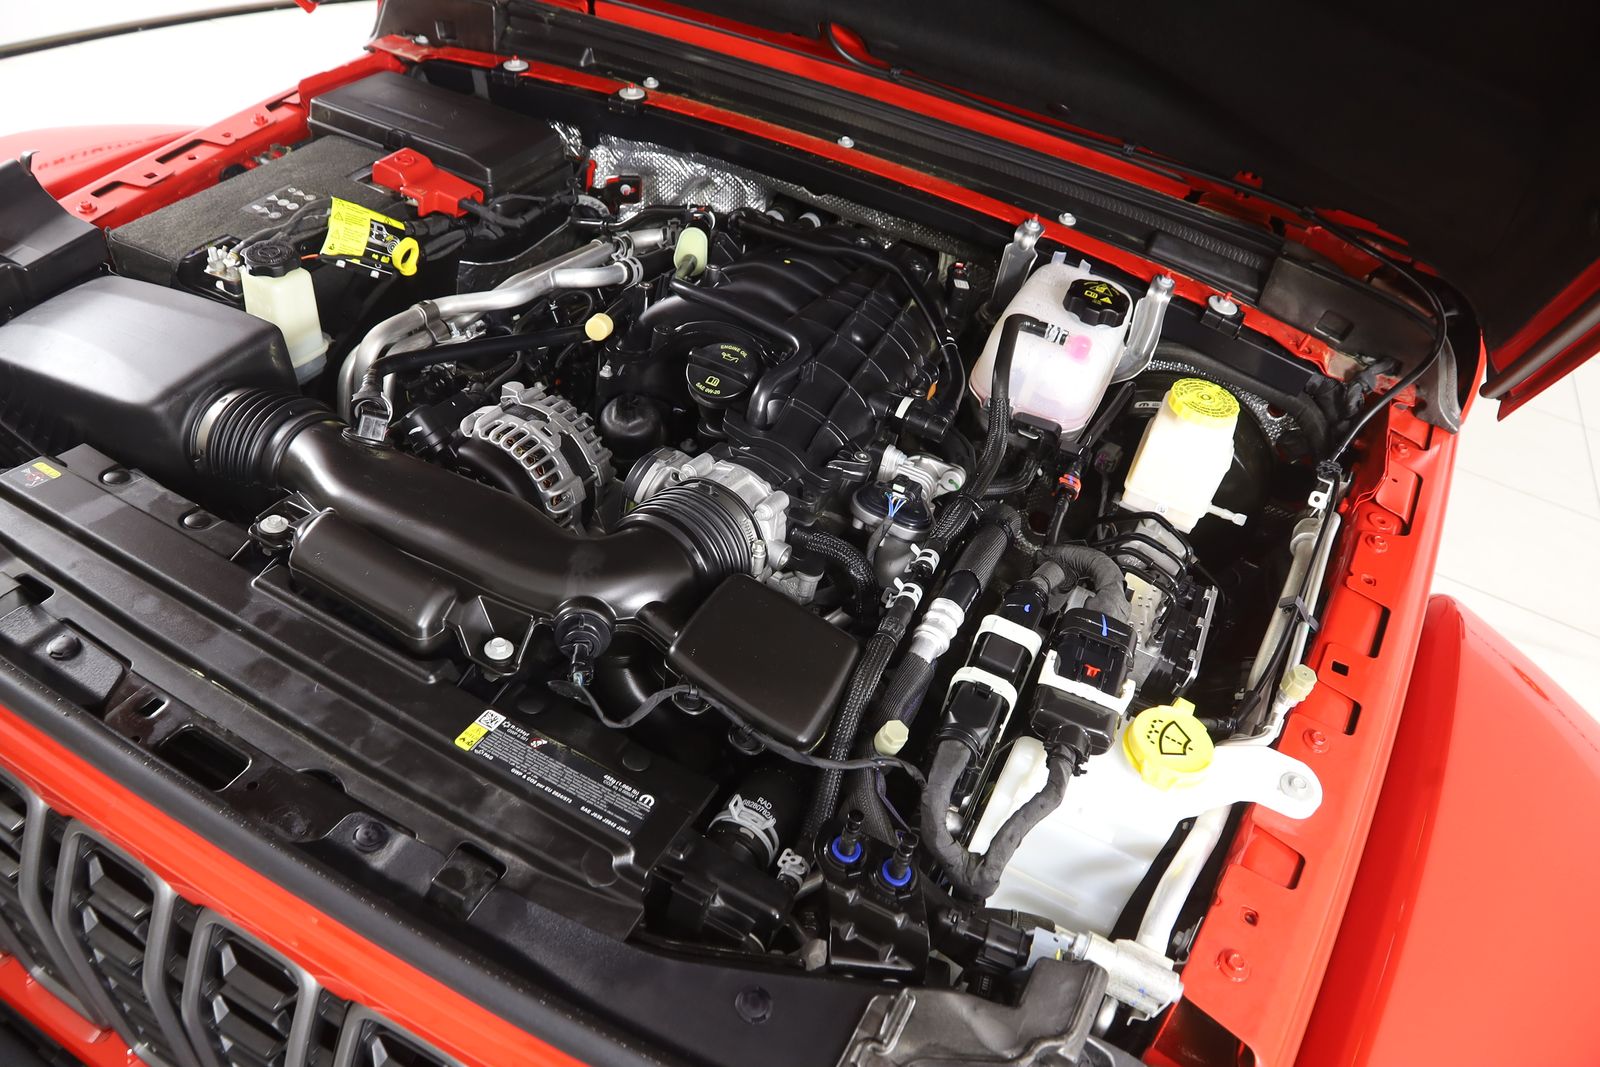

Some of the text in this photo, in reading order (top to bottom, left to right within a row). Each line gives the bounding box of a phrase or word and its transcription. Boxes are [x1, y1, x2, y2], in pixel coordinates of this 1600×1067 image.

[720, 344, 748, 359] ENGINE OIL
[695, 382, 721, 395] SAE 0W-20
[510, 767, 523, 776] GWP
[526, 776, 538, 785] CO2
[535, 782, 545, 790] per
[544, 785, 553, 793] EU
[580, 805, 592, 814] SAE
[757, 797, 772, 810] RAD
